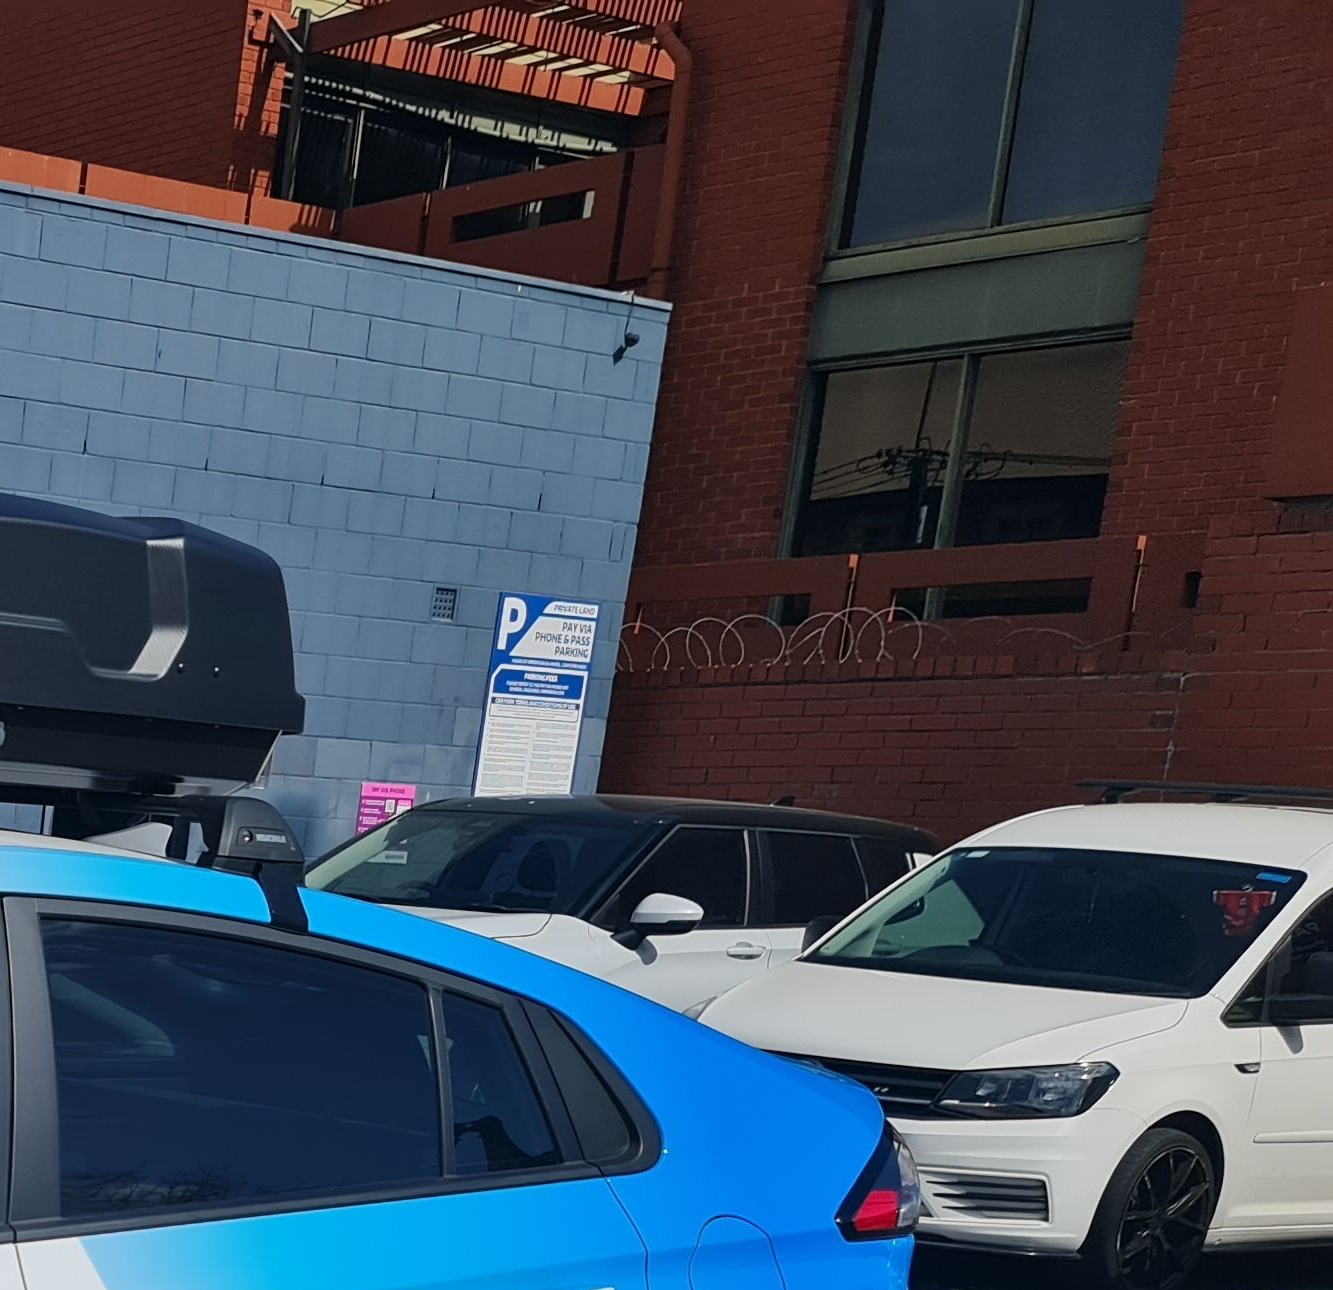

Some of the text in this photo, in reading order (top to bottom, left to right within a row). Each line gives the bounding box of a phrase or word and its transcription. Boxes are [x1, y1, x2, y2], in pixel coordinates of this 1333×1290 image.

[497, 597, 527, 651] P
[562, 622, 592, 634] PAY VIA
[535, 632, 590, 647] PHONE & PASS
[554, 646, 589, 659] PARKING
